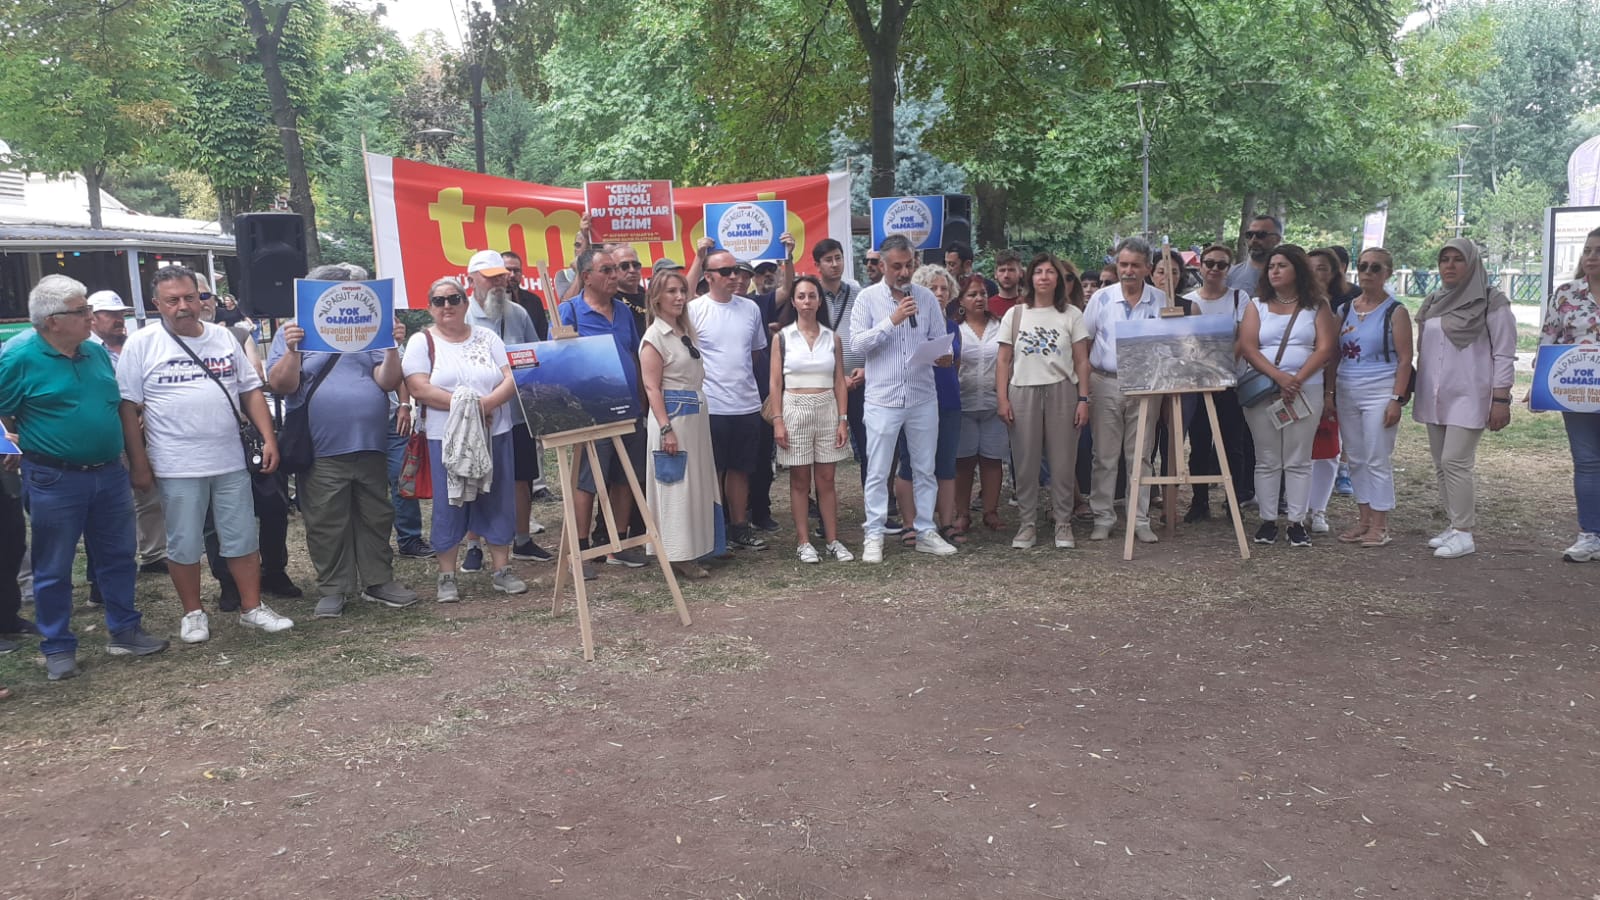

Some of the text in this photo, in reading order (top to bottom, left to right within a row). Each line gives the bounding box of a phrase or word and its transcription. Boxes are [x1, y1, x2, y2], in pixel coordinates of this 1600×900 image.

[608, 194, 652, 207] DEFOL!
[591, 206, 670, 218] BU TOPRAKLAR
[611, 216, 652, 231] BİZİM!
[727, 229, 764, 238] OLMASIN!
[339, 307, 360, 316] YOK
[325, 315, 373, 325] OLMASIN!
